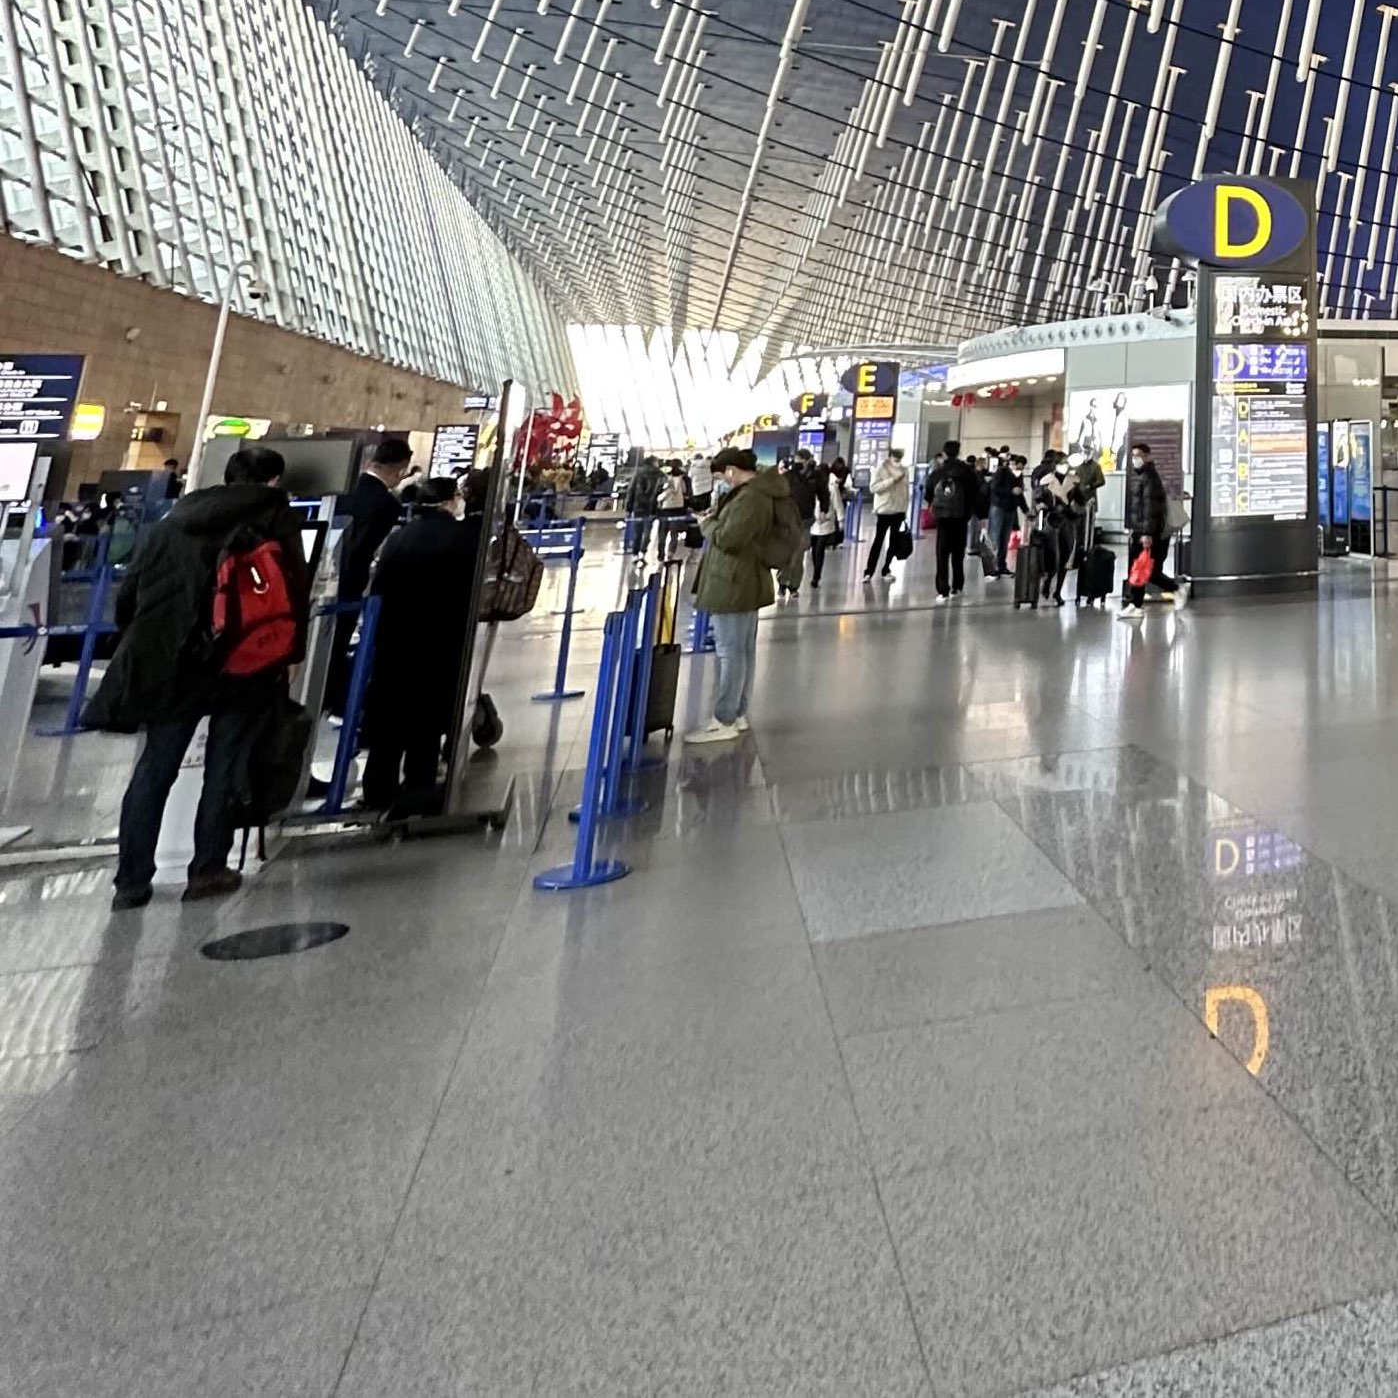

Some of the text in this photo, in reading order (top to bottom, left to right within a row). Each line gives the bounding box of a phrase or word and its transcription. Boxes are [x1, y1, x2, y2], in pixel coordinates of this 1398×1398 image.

[1215, 185, 1272, 258] D
[1222, 346, 1245, 376] D
[858, 365, 877, 392] E
[801, 394, 815, 414] F
[1239, 401, 1249, 416] D
[760, 414, 772, 429] G
